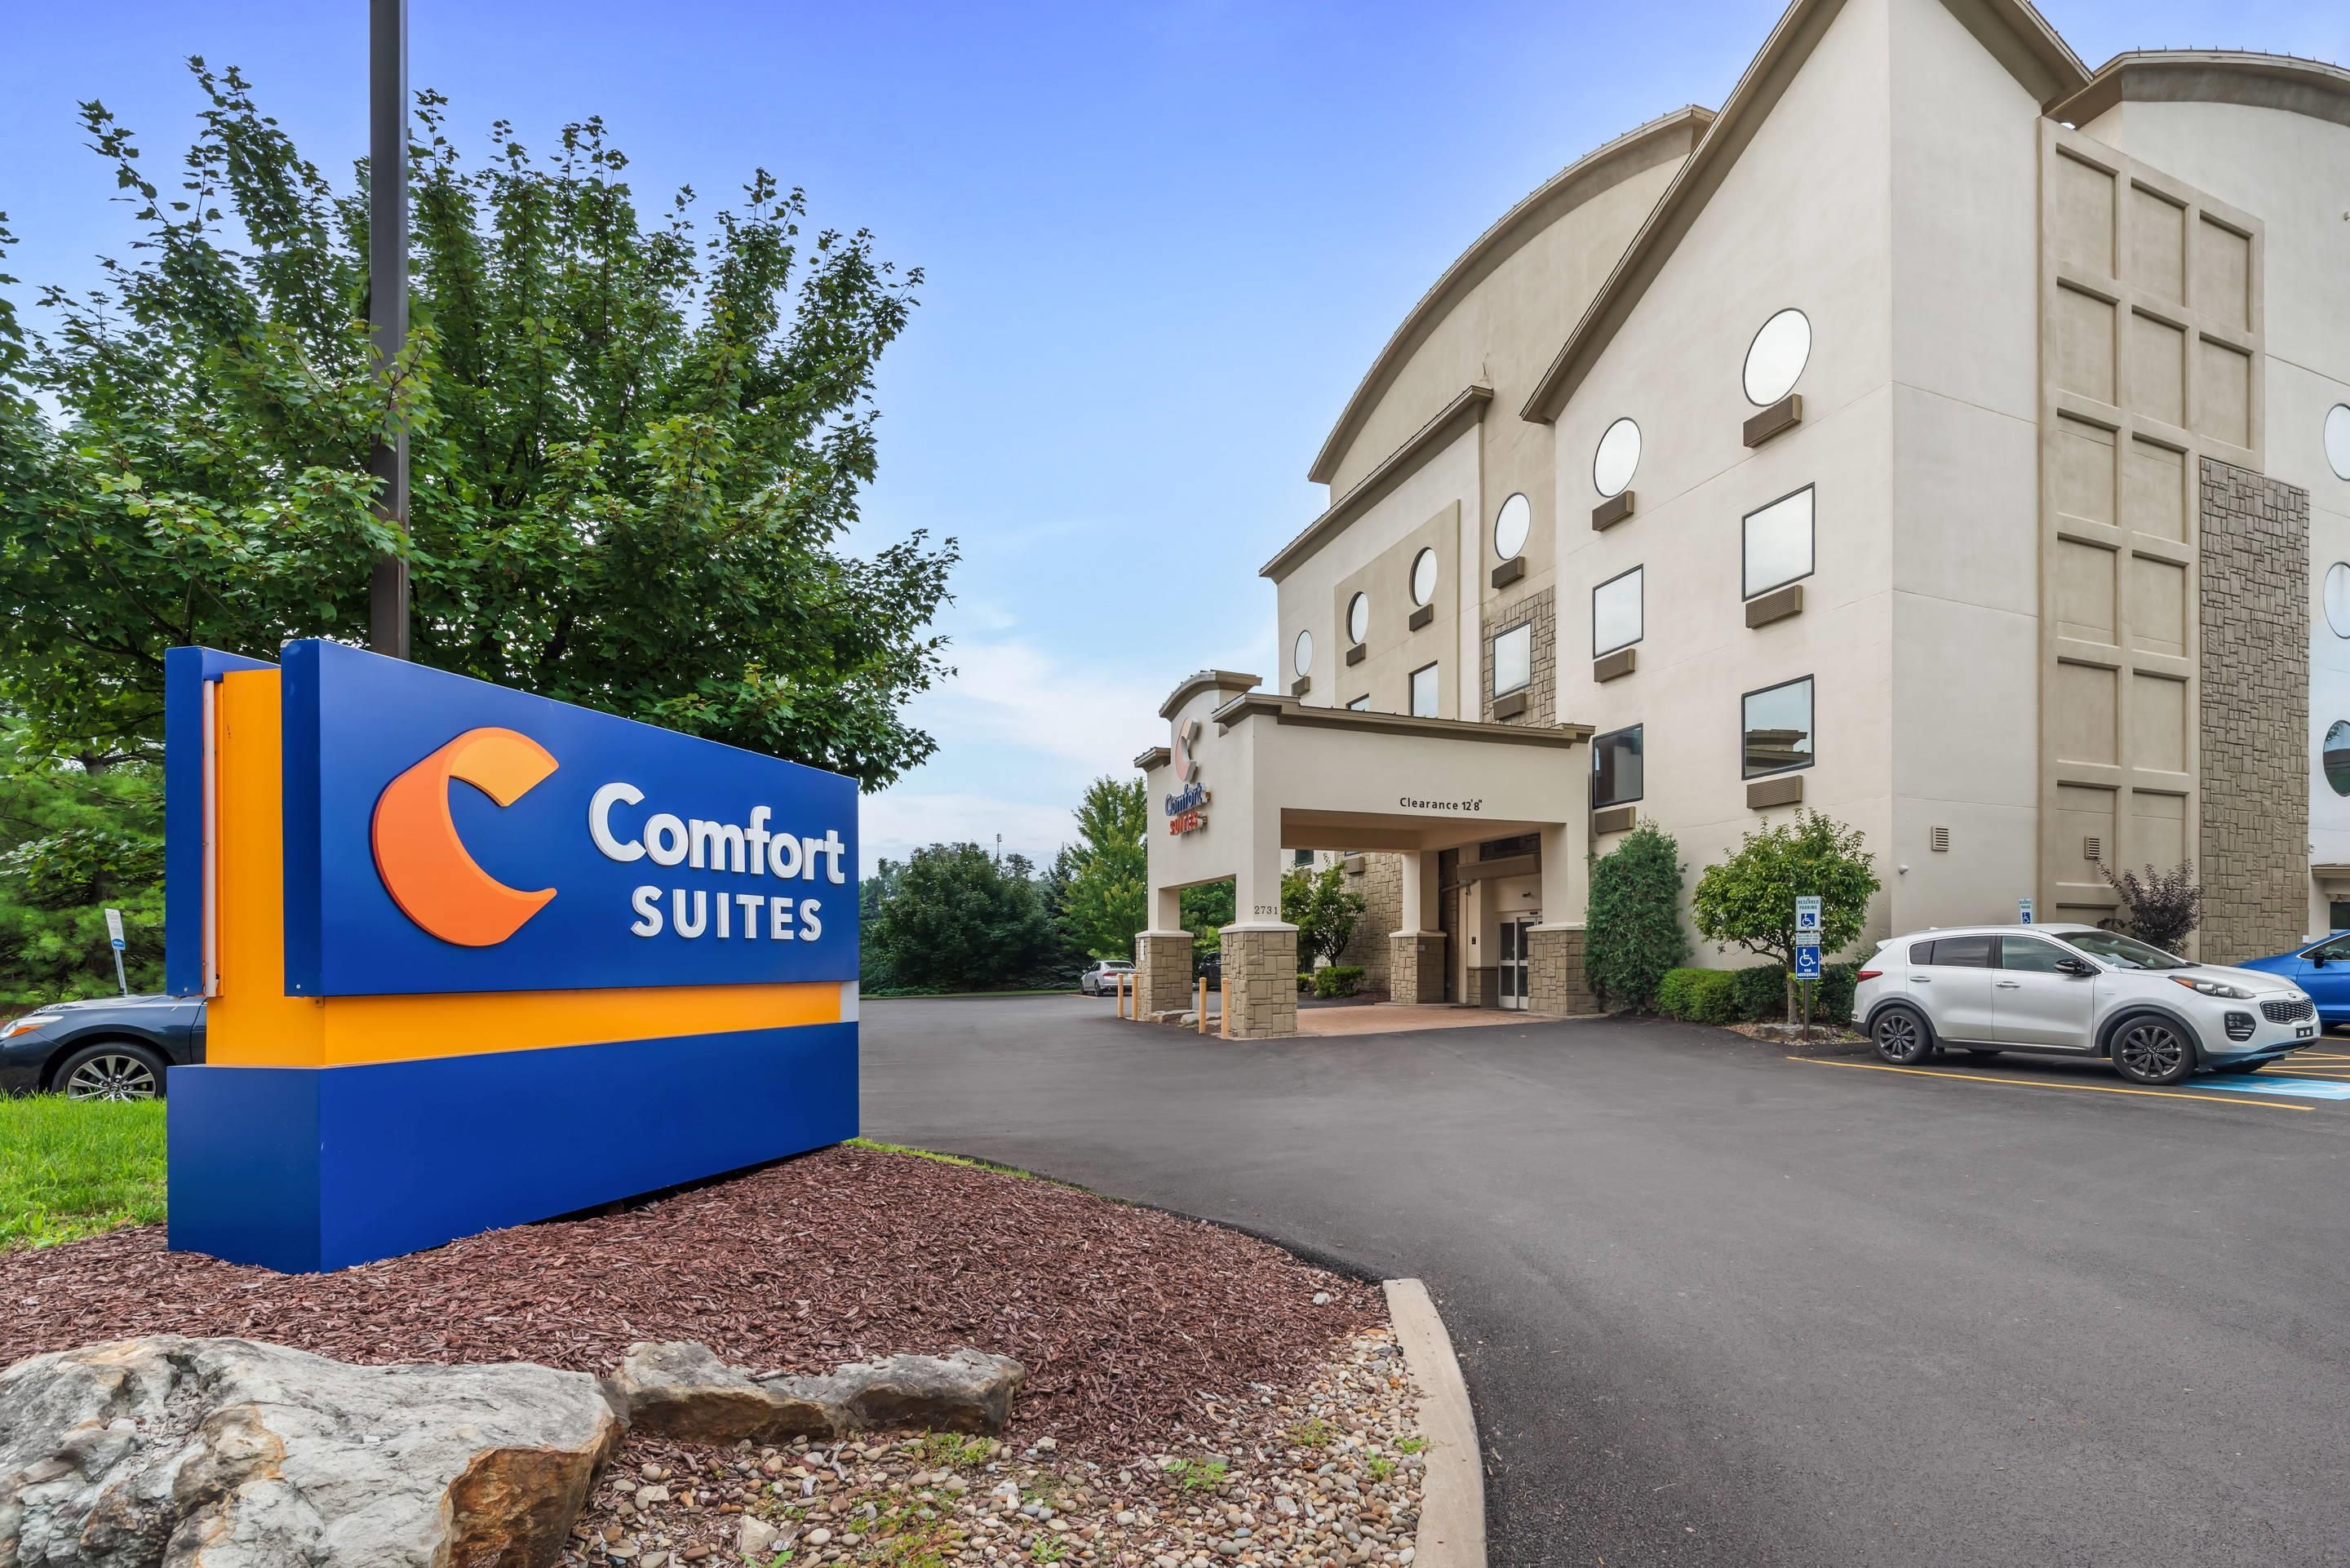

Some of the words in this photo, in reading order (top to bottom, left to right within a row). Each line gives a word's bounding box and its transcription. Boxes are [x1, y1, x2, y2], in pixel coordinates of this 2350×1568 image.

[1165, 782, 1202, 816] Comfort
[1399, 797, 1458, 810] Clearance
[588, 782, 845, 884] Comfort
[1169, 809, 1199, 836] SUITES
[631, 885, 822, 941] SUITES
[1254, 906, 1278, 915] 2731
